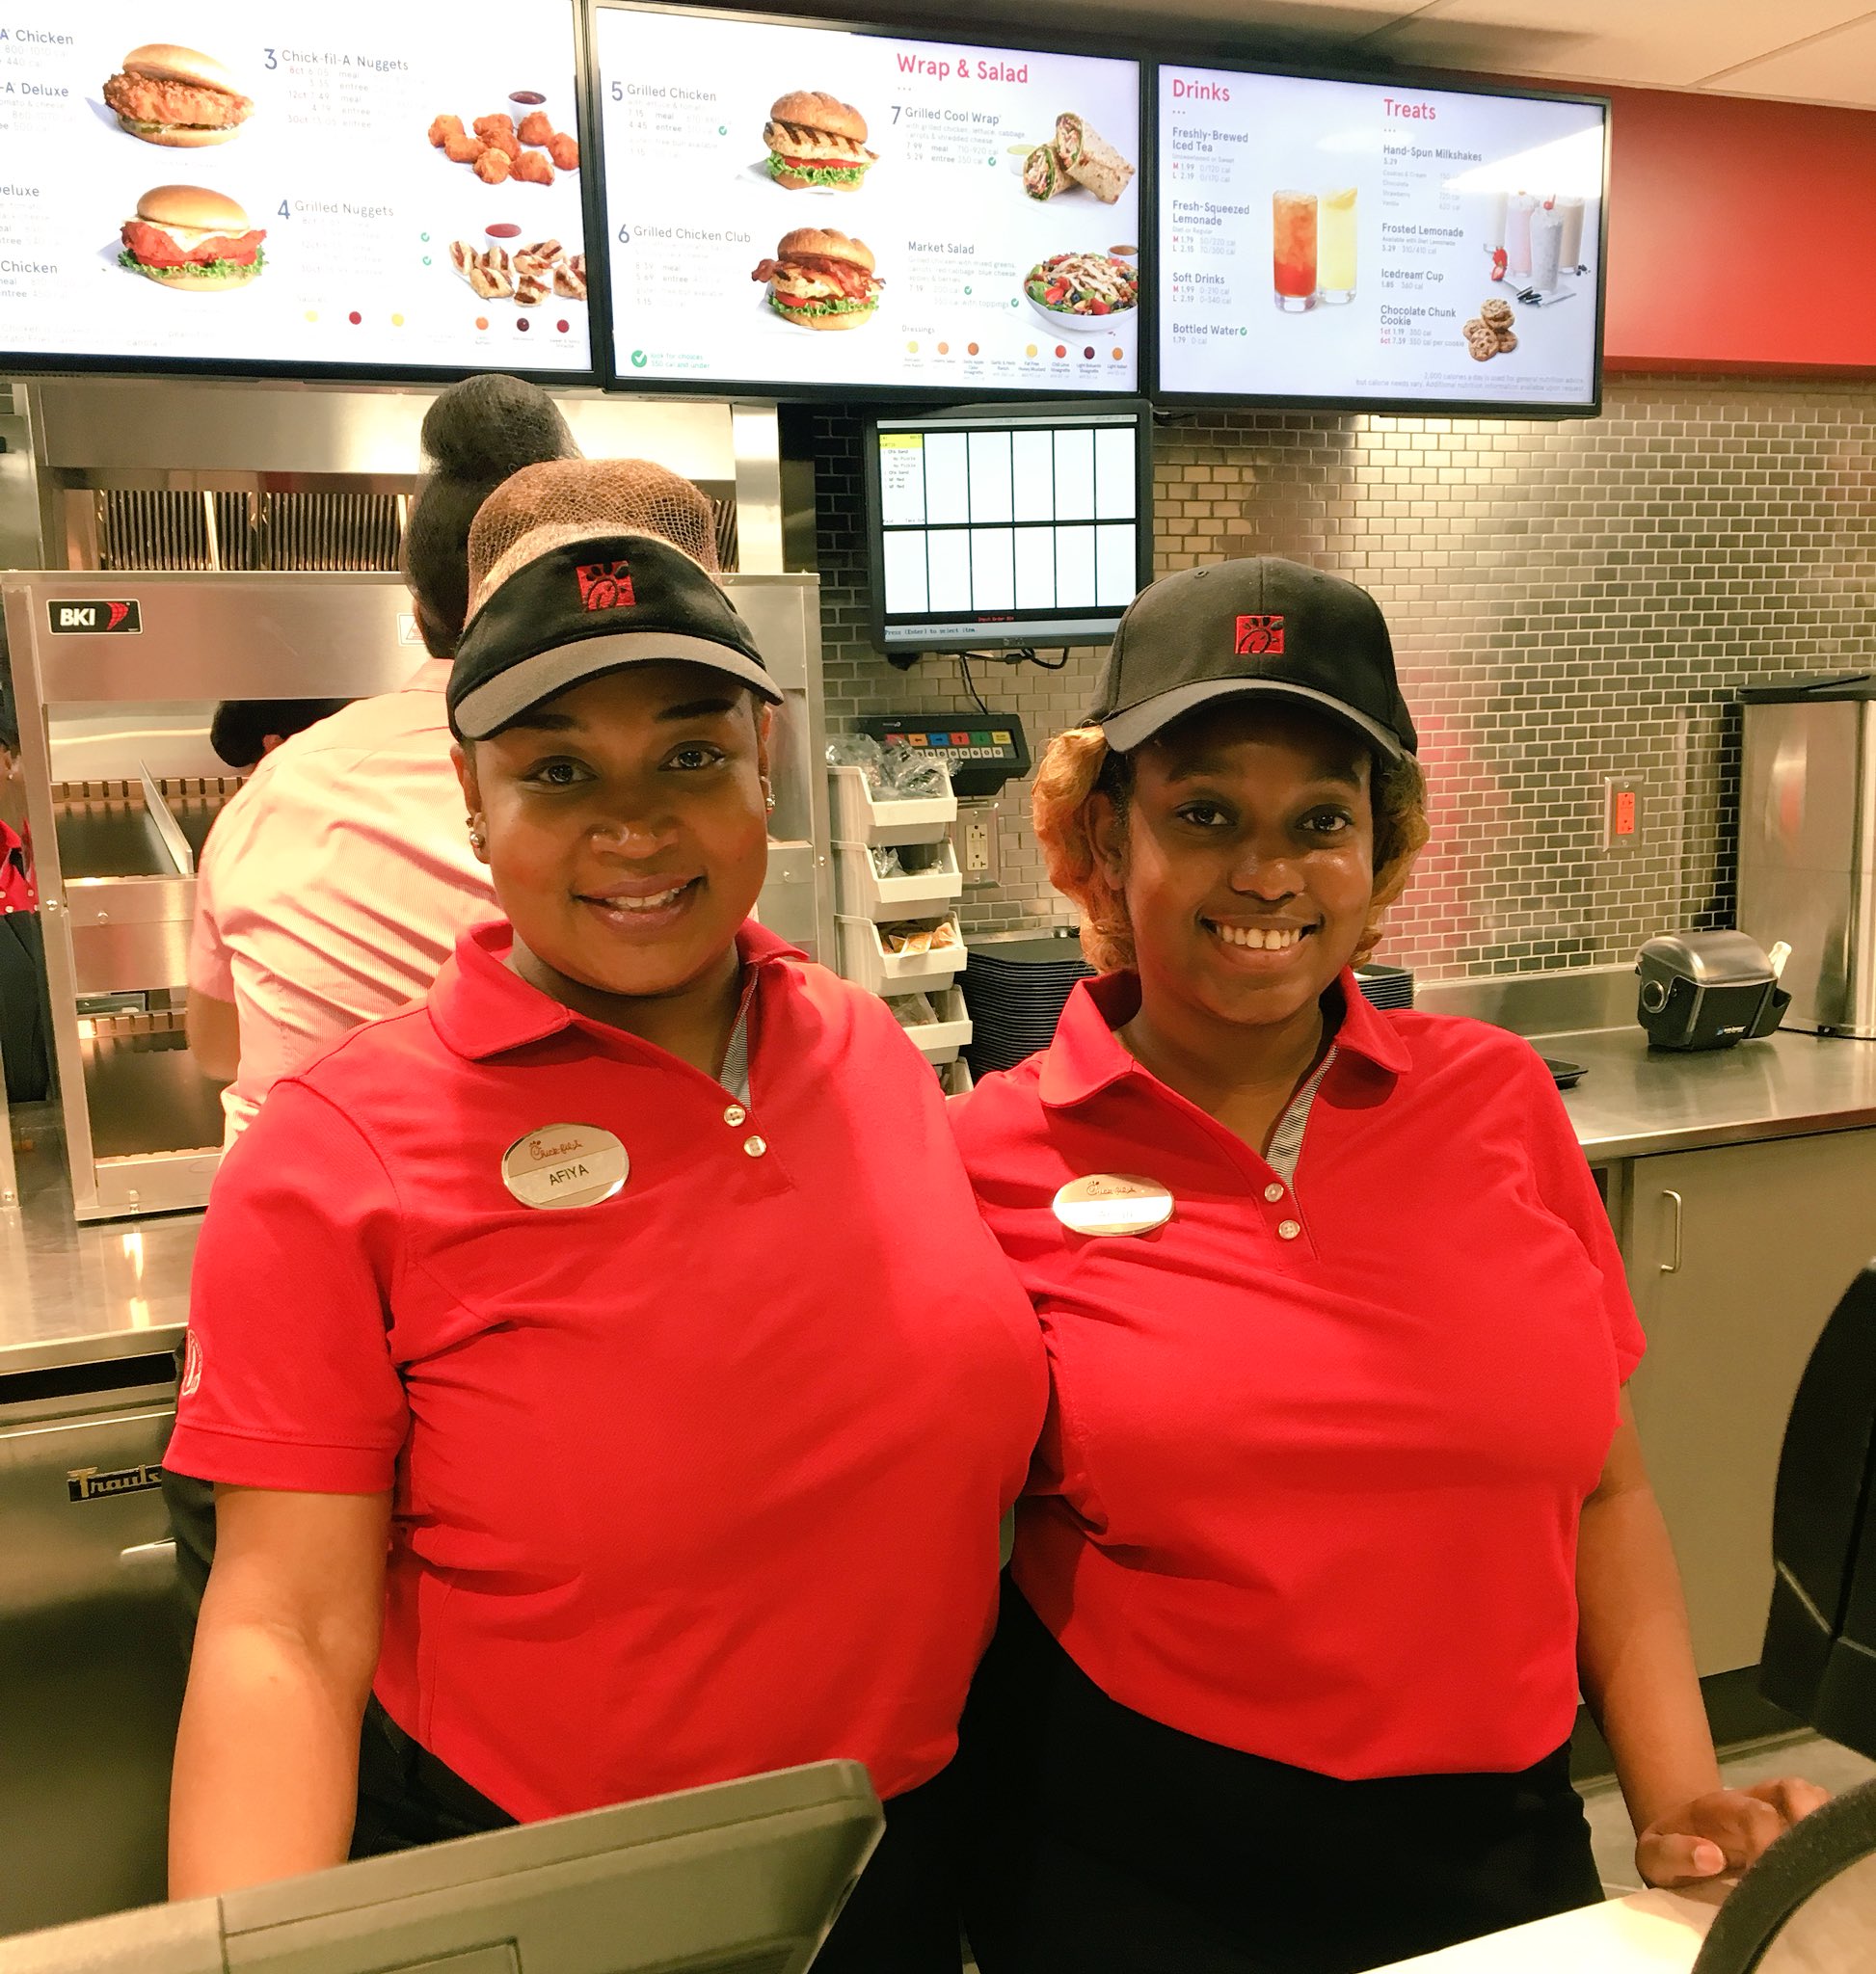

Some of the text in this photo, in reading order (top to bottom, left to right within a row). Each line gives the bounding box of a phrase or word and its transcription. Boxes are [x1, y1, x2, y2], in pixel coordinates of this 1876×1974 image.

[15, 29, 74, 45] Chicken
[263, 48, 278, 70] 3
[281, 49, 409, 72] Chick-fil-A Nuggets
[897, 52, 1028, 84] Wrap & Salad
[21, 82, 69, 97] Deluxe
[339, 83, 369, 92] entree
[611, 80, 624, 101] 5
[627, 83, 717, 101] Grilled Chicken
[1172, 78, 1231, 102] Drinks
[656, 112, 674, 120] meal
[890, 105, 901, 125] 7
[905, 106, 1000, 126] Grilled Cool Wrap
[1383, 97, 1436, 120] Treats
[656, 123, 683, 133] entree
[1172, 139, 1213, 152] Iced Tea
[931, 154, 955, 163] entree
[1383, 145, 1483, 162] Hand-Spun Milkshakes
[277, 199, 290, 221] 4
[294, 200, 394, 219] Grilled Nuggets
[1172, 200, 1250, 215] Fresh-Squeezed
[1172, 212, 1222, 227] Lemonade
[618, 223, 630, 244] 6
[633, 225, 752, 243] Grilled Chicken Club
[1381, 223, 1463, 237] Frosted Lemonade
[908, 240, 975, 255] Market Salad
[0, 259, 58, 275] Chicken
[662, 275, 688, 283] entree
[1172, 272, 1225, 285] Soft Drinks
[1381, 268, 1444, 282] Icedream Cup
[1380, 305, 1457, 318] Chocolate Chunk
[1380, 315, 1411, 326] Cookie
[901, 324, 935, 335] Dressings
[1172, 323, 1239, 335] Bottled Water
[690, 361, 710, 370] under
[60, 608, 95, 626] BKI
[549, 1163, 589, 1187] AFIYA
